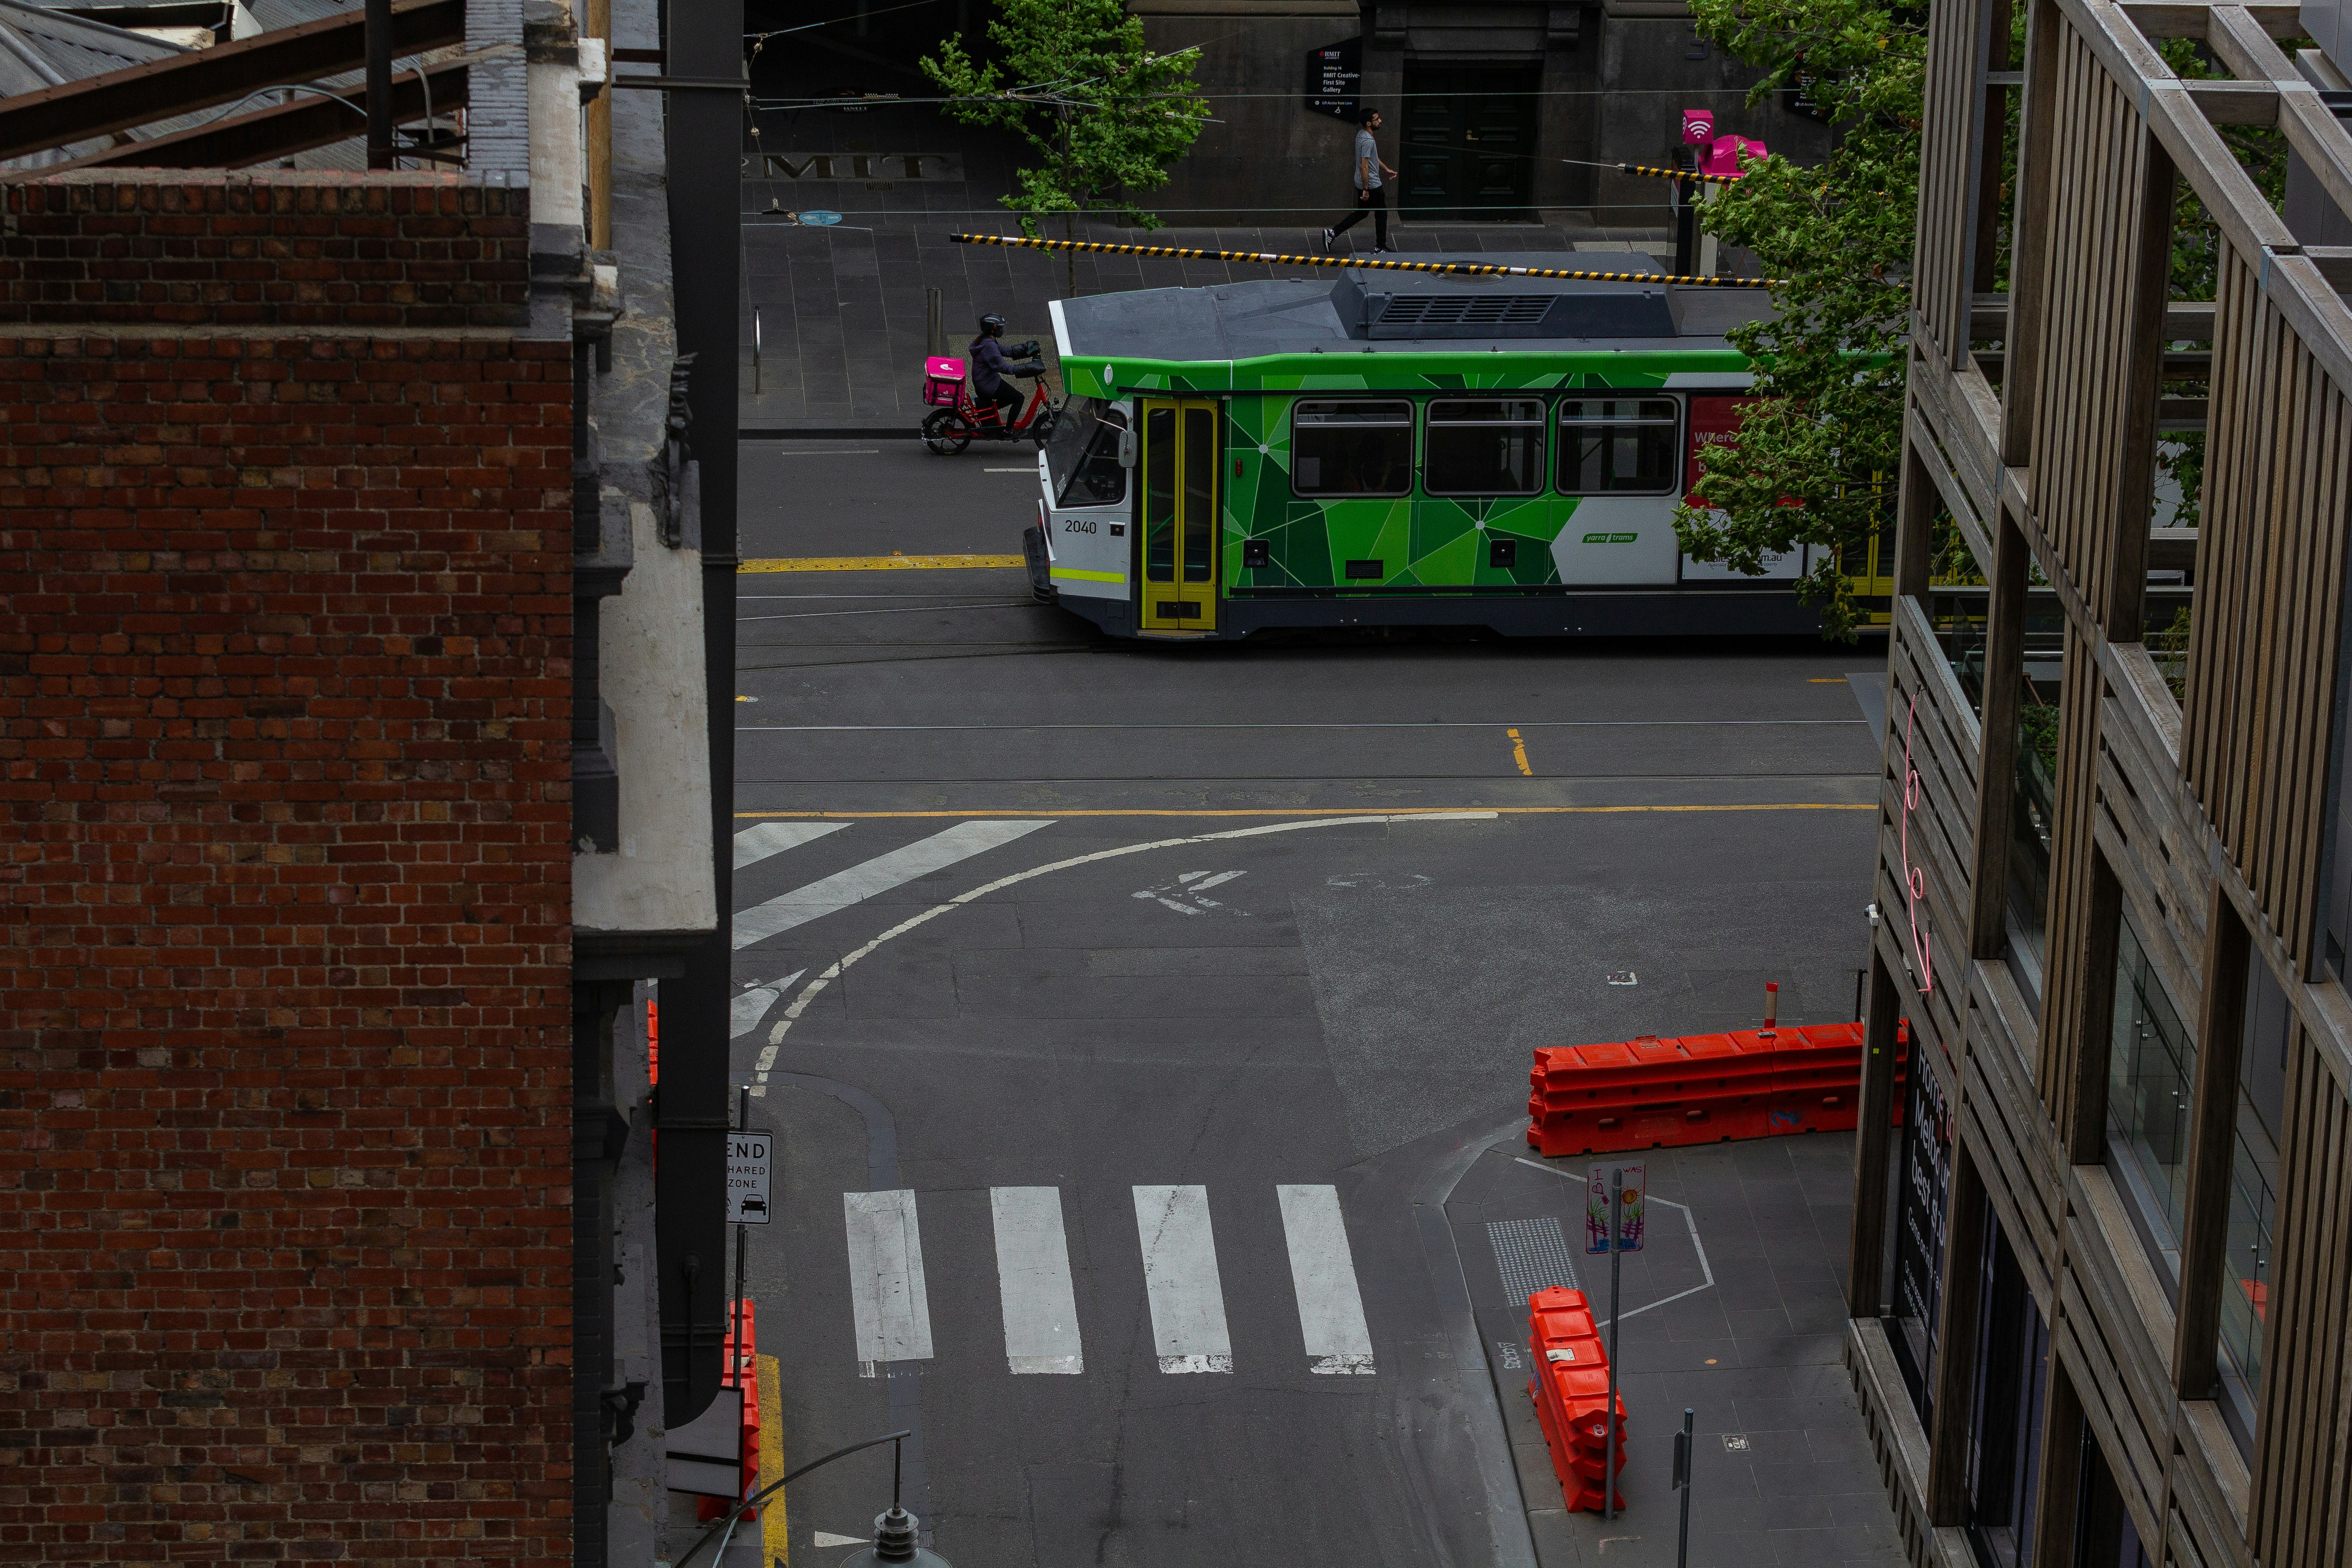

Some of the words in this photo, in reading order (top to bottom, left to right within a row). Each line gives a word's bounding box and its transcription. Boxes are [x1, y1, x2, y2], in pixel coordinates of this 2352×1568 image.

[1065, 520, 1097, 534] 2040
[1918, 1044, 1944, 1122] Home
[728, 1165, 765, 1175] HARED
[1912, 1139, 1931, 1215] best
[728, 1179, 757, 1188] ZONE
[1908, 1206, 1920, 1245] Come
